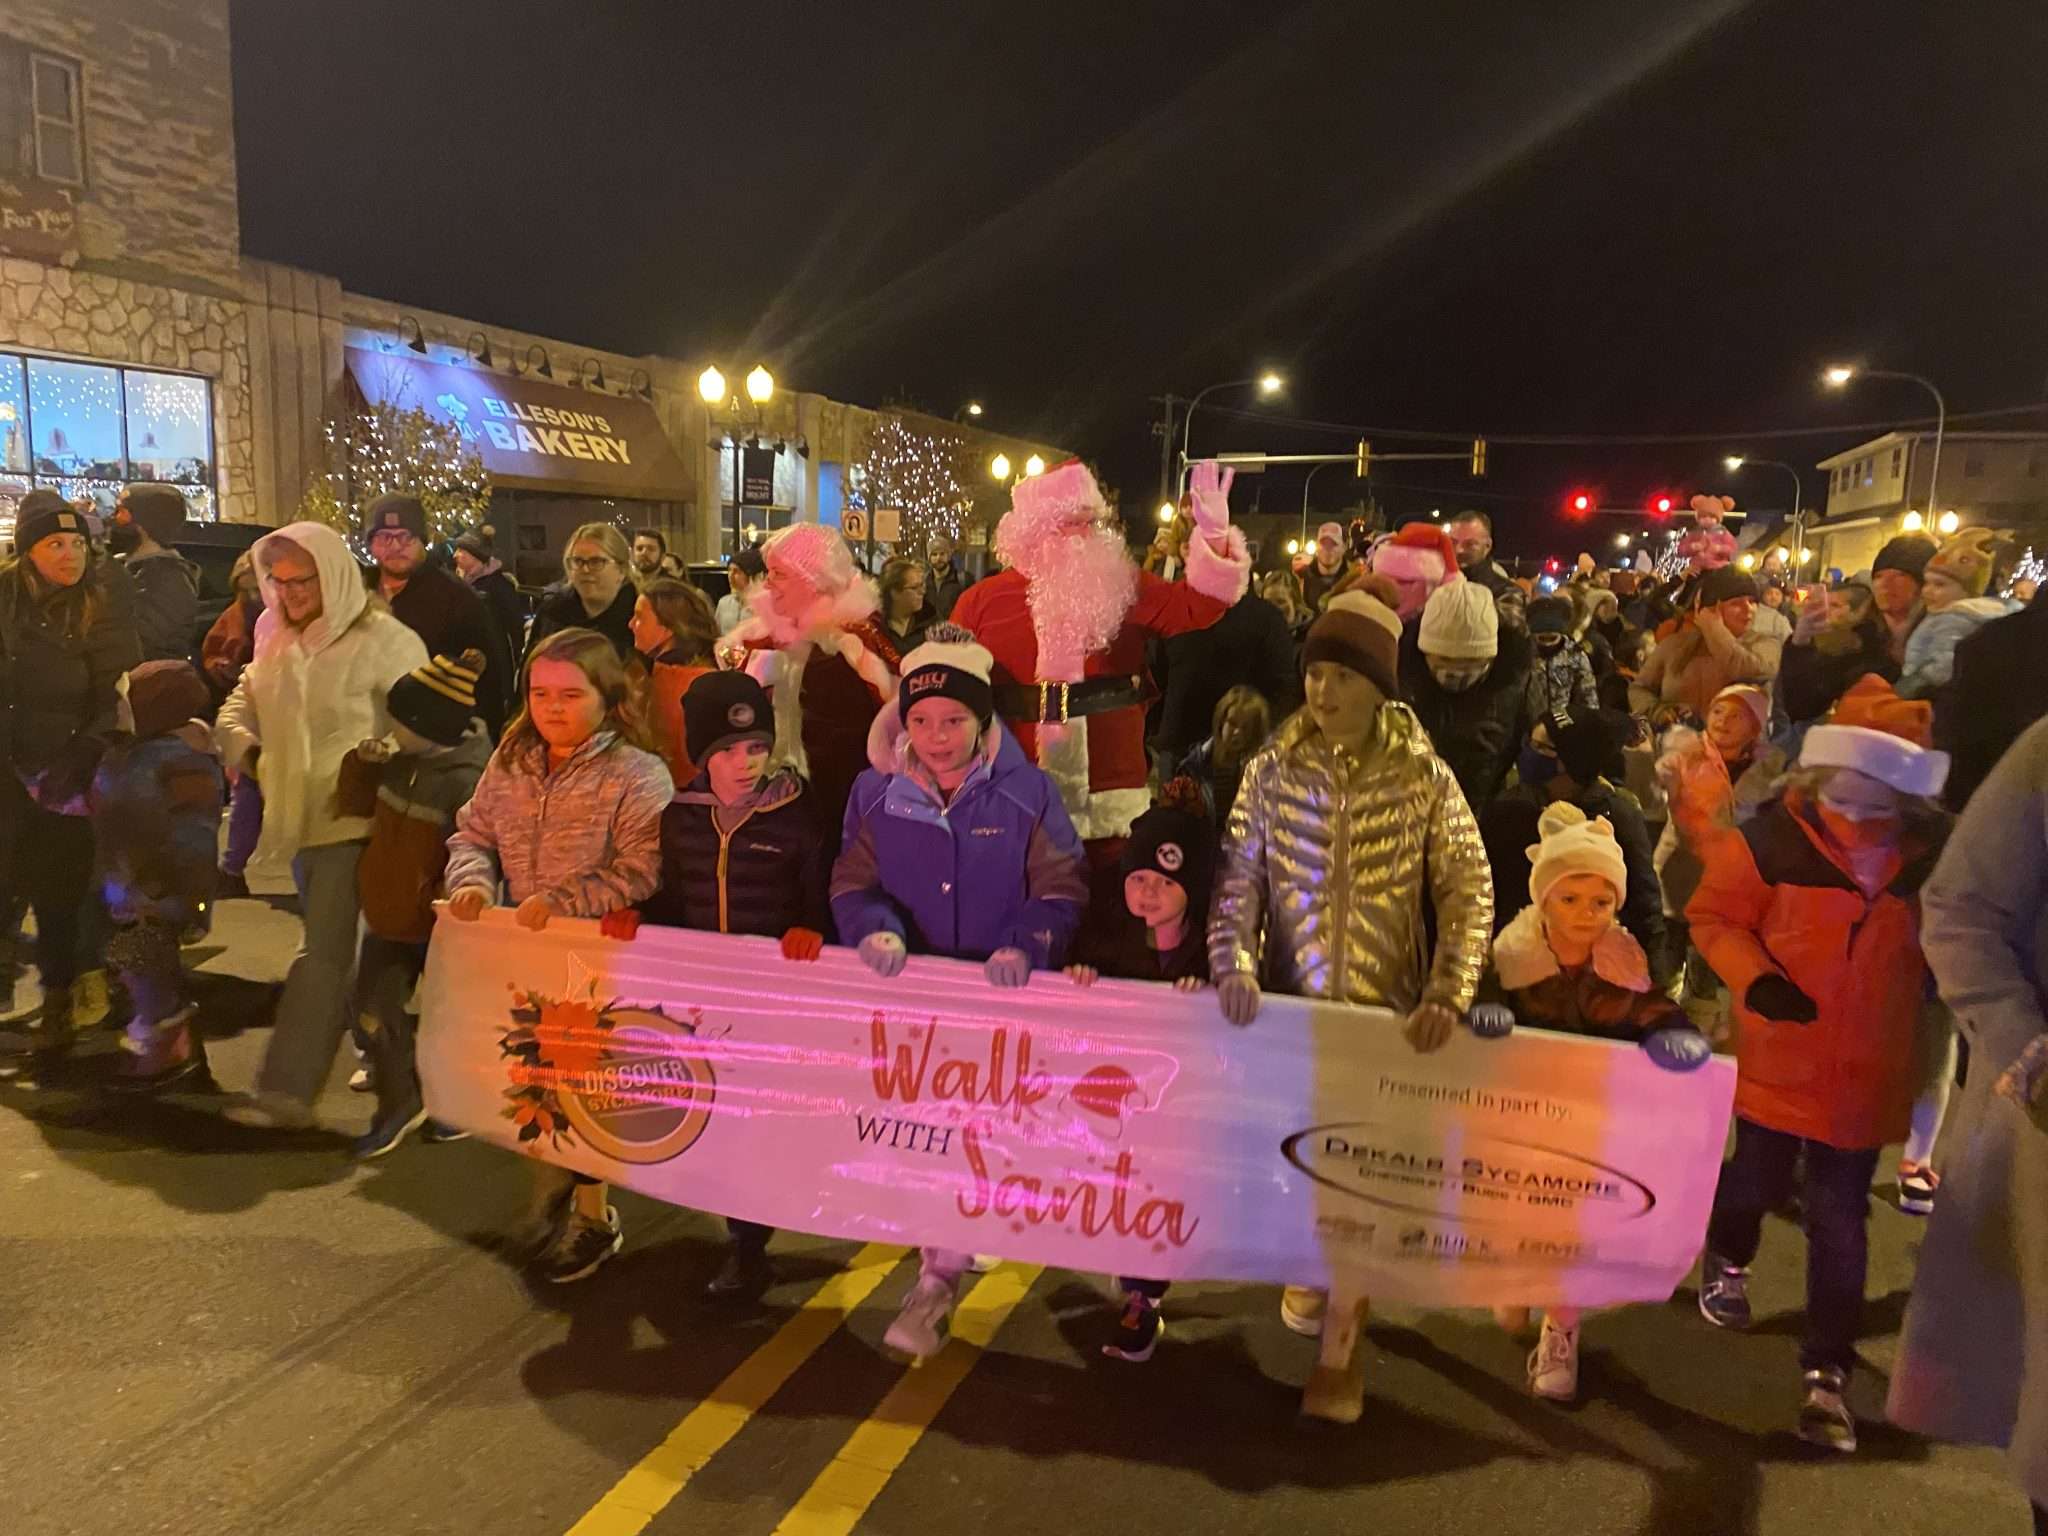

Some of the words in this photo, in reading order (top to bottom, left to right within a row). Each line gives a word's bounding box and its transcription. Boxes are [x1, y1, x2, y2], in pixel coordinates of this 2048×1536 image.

[482, 397, 612, 434] ELLESON'S
[482, 419, 632, 465] BAKERY
[583, 1060, 687, 1097] DISCOVER
[870, 1009, 1055, 1123] Walk
[1378, 1076, 1471, 1105] Presented
[1475, 1089, 1495, 1108] in
[1500, 1096, 1540, 1114] part
[854, 1114, 956, 1155] WITH
[955, 1119, 1200, 1247] Santa
